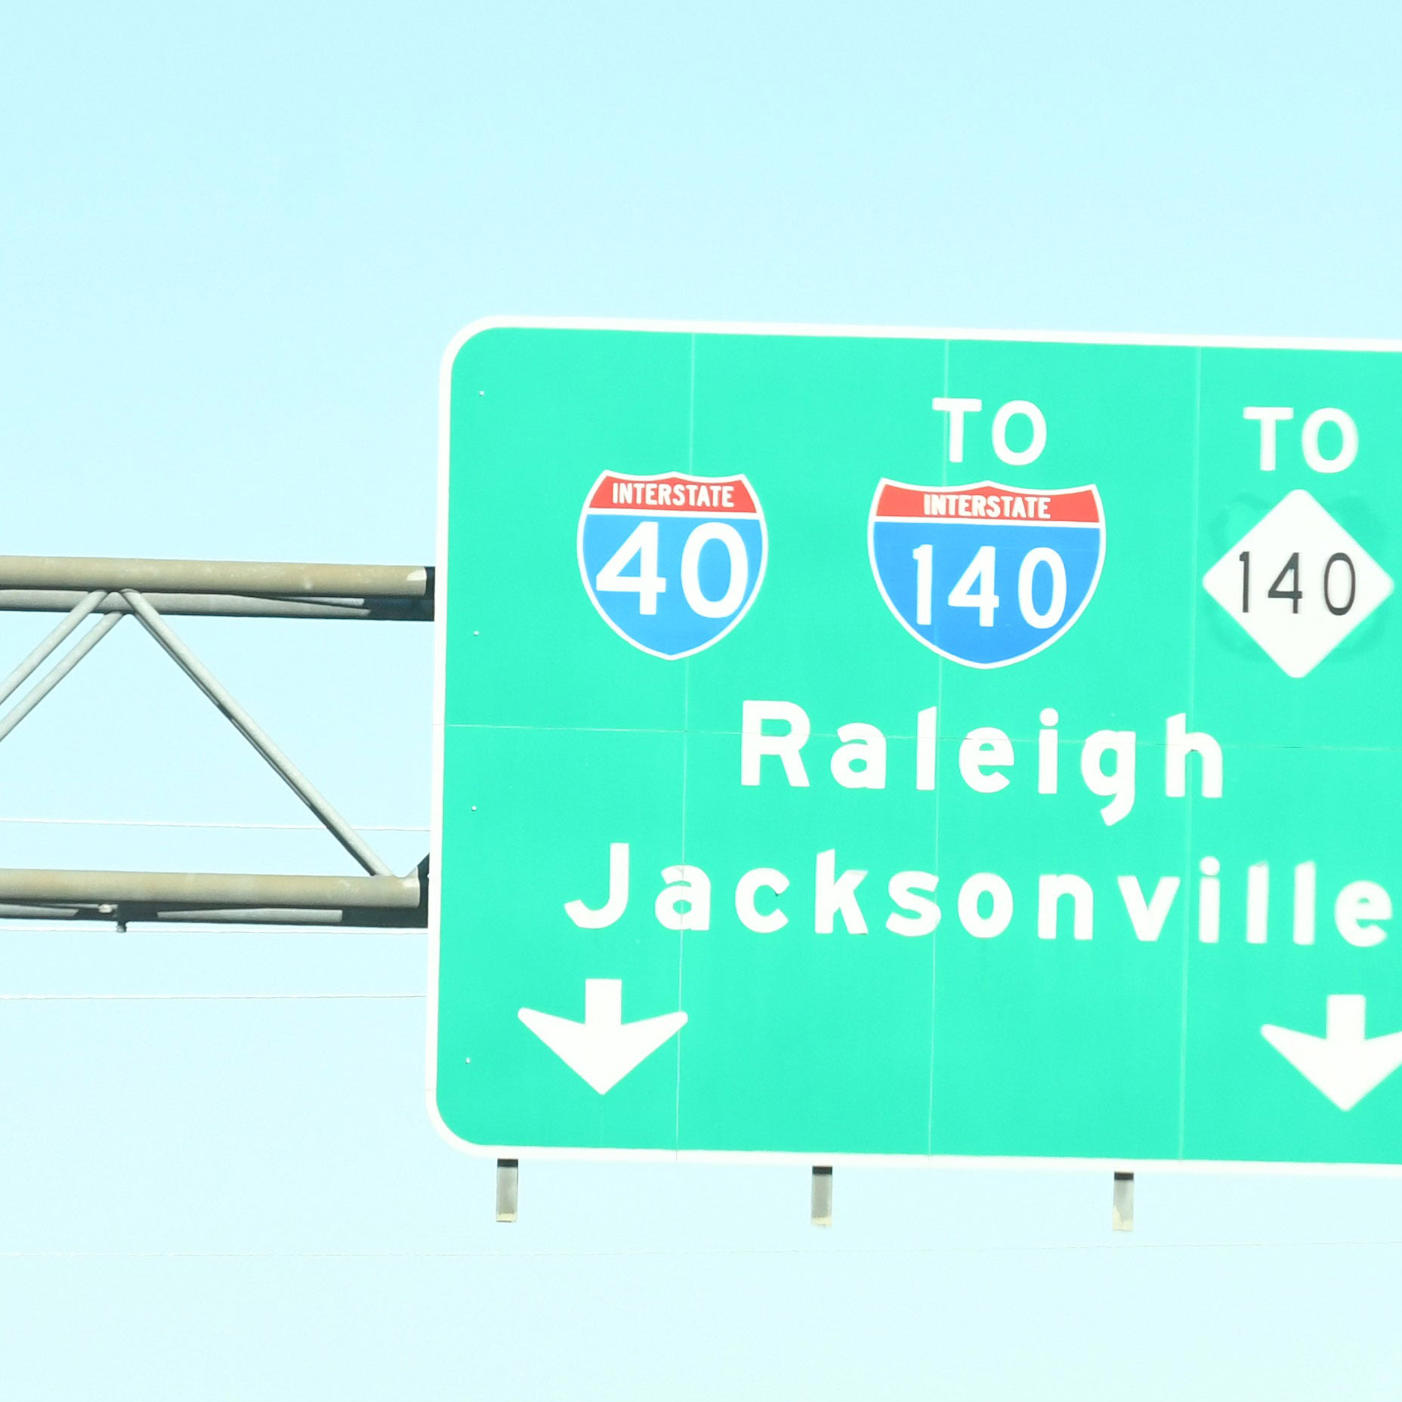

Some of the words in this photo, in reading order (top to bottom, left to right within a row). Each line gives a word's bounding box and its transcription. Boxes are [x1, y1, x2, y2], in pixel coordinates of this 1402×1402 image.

[933, 398, 1046, 465] TO
[1244, 407, 1358, 473] TO
[612, 481, 736, 510] INTERSTATE
[922, 492, 1052, 521] INTERSTATE
[595, 522, 748, 618] 40
[911, 543, 1067, 629] 140
[1240, 552, 1355, 615] 140
[742, 700, 1222, 826] Raleigh
[565, 843, 1392, 947] Jacksonville
